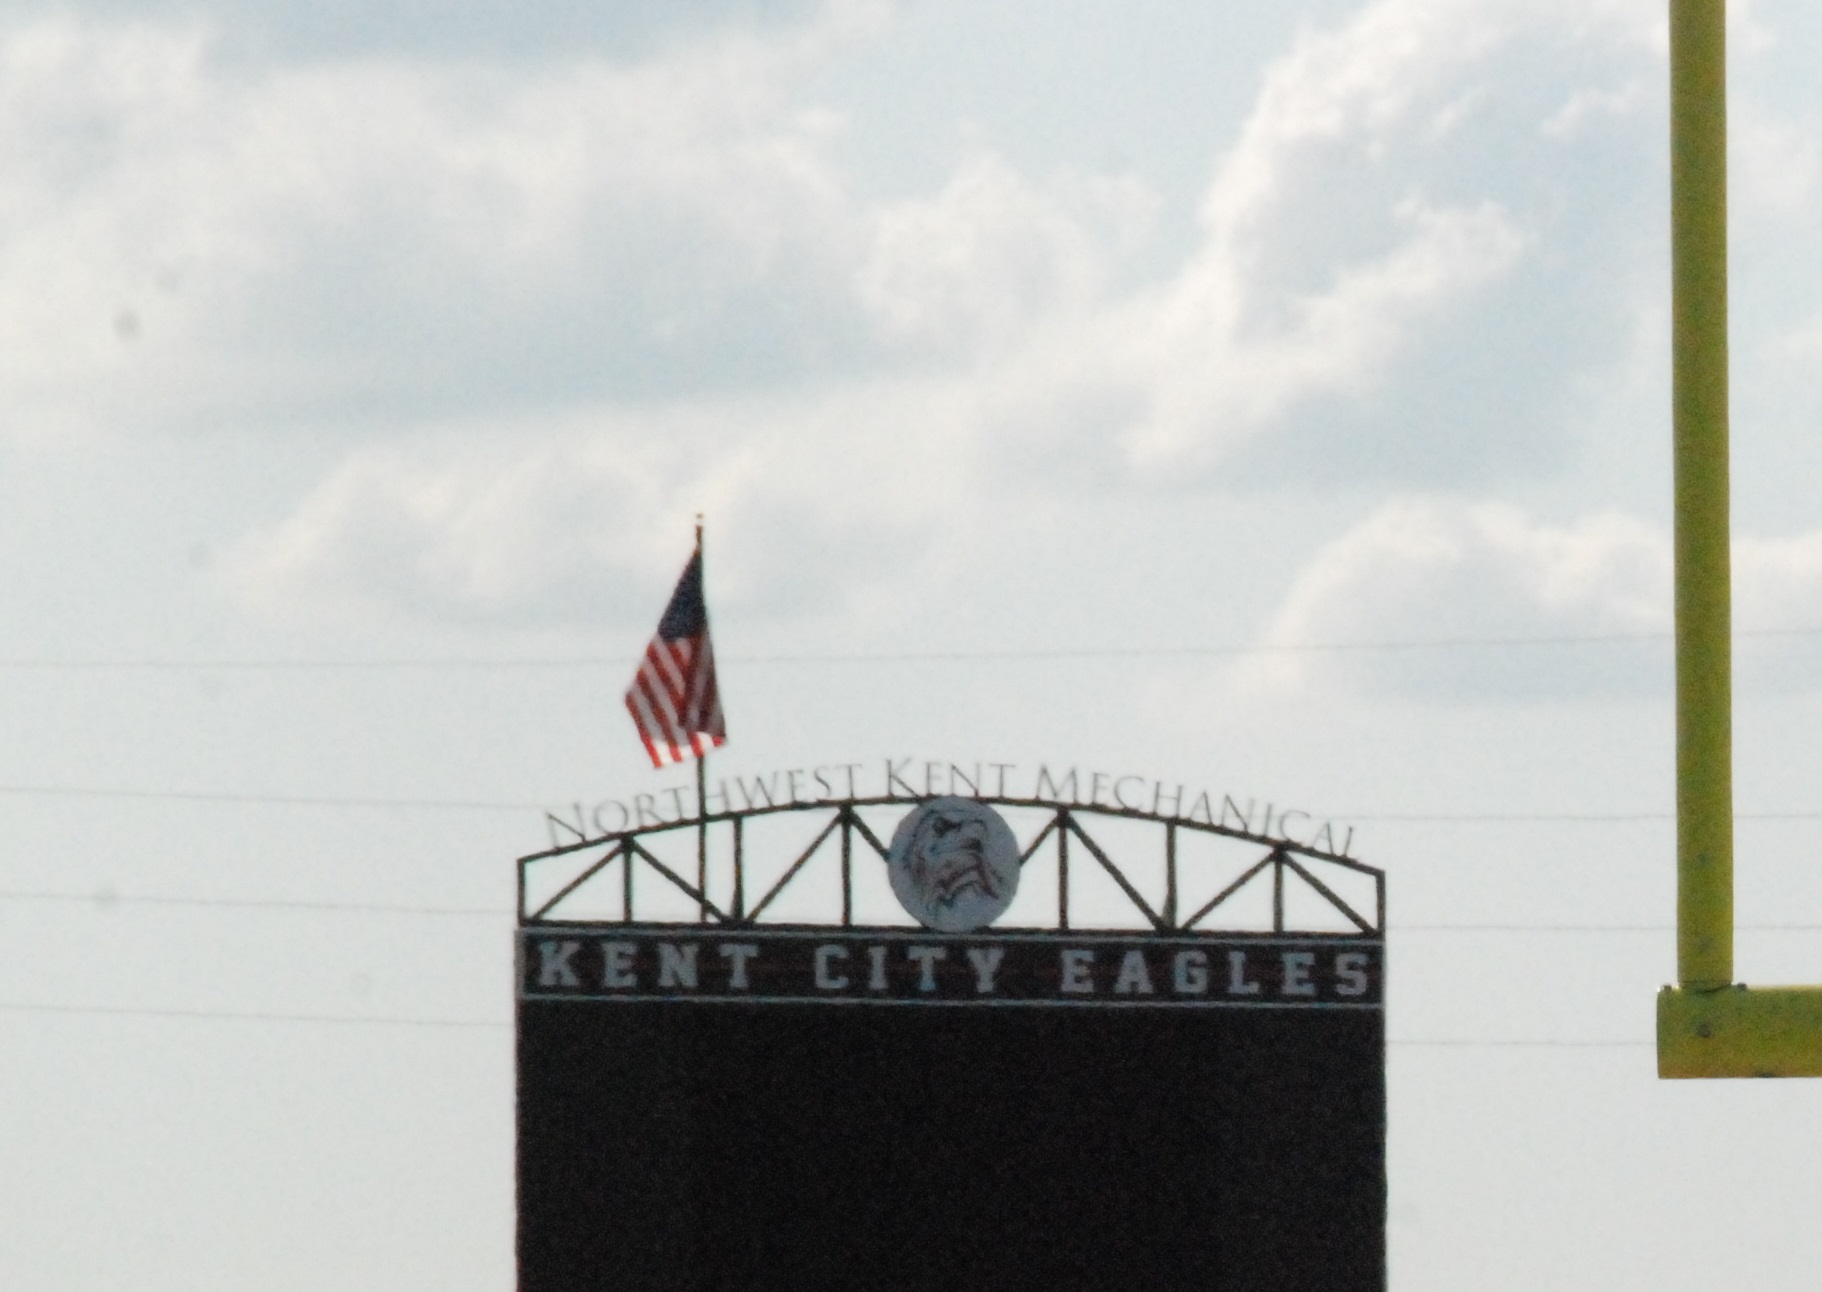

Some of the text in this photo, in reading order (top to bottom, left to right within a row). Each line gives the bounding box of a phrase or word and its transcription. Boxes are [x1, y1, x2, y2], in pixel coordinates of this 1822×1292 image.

[546, 757, 1362, 862] NORTHWEST KENT MECHANICAL
[536, 940, 1370, 997] KENT CITY EAGLES
